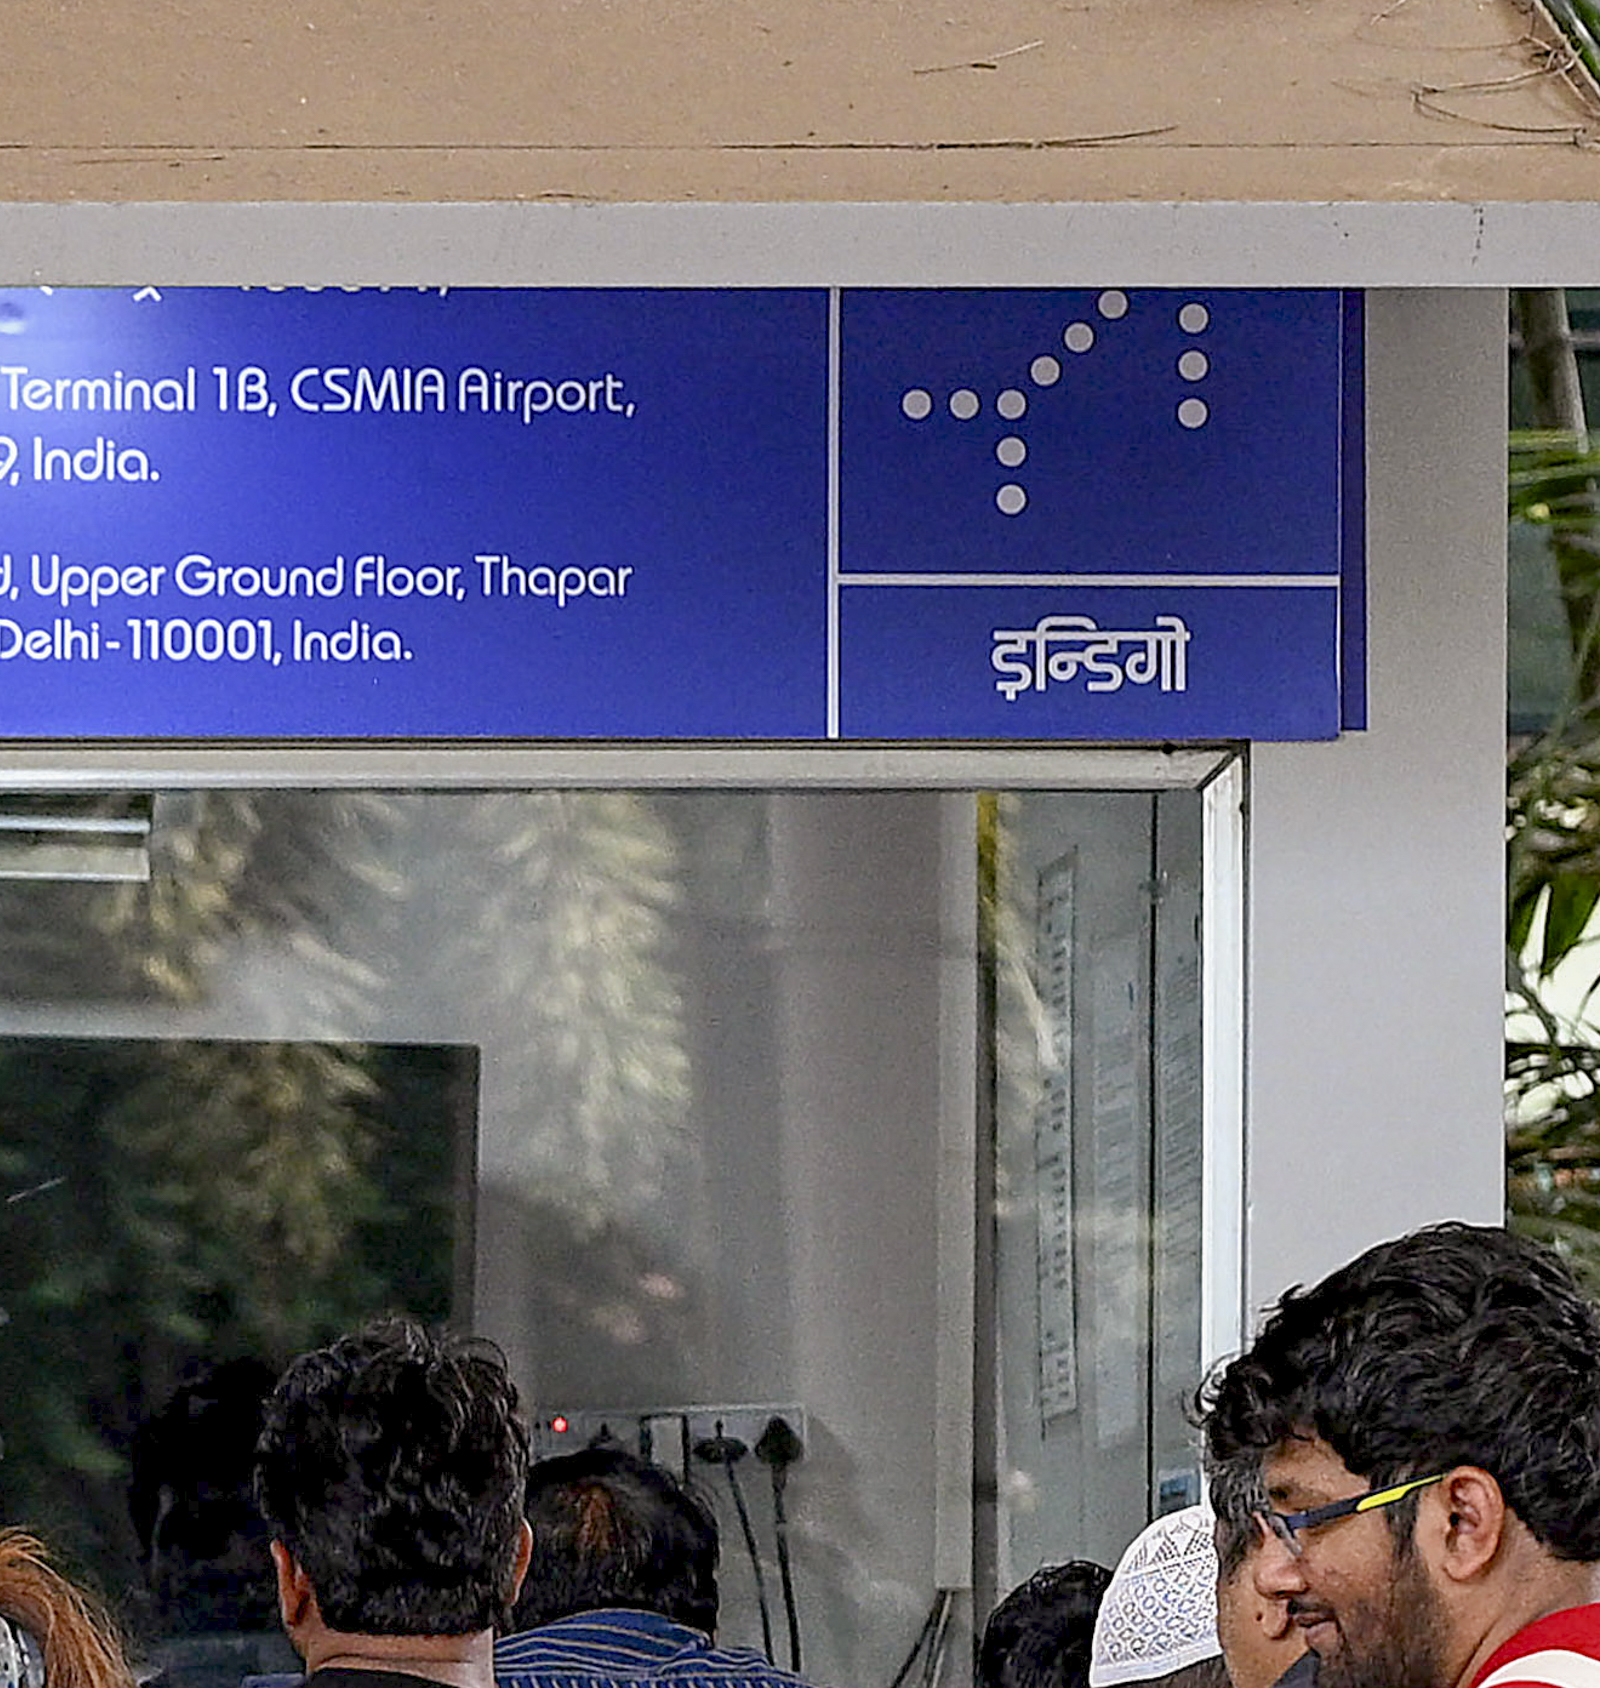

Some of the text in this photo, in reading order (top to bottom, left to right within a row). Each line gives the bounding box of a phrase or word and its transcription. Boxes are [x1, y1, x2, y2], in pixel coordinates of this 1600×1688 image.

[1, 367, 194, 410] Terminal
[213, 367, 276, 417] 1B,
[291, 368, 444, 411] CSMIA
[459, 368, 634, 424] Airport,
[34, 437, 159, 480] India.
[32, 555, 166, 607] Upper
[176, 555, 343, 596] Ground
[355, 556, 464, 600] Floor,
[475, 556, 632, 607] Thapar
[294, 620, 412, 660] India.
[992, 616, 1191, 701] इन्डिगो
